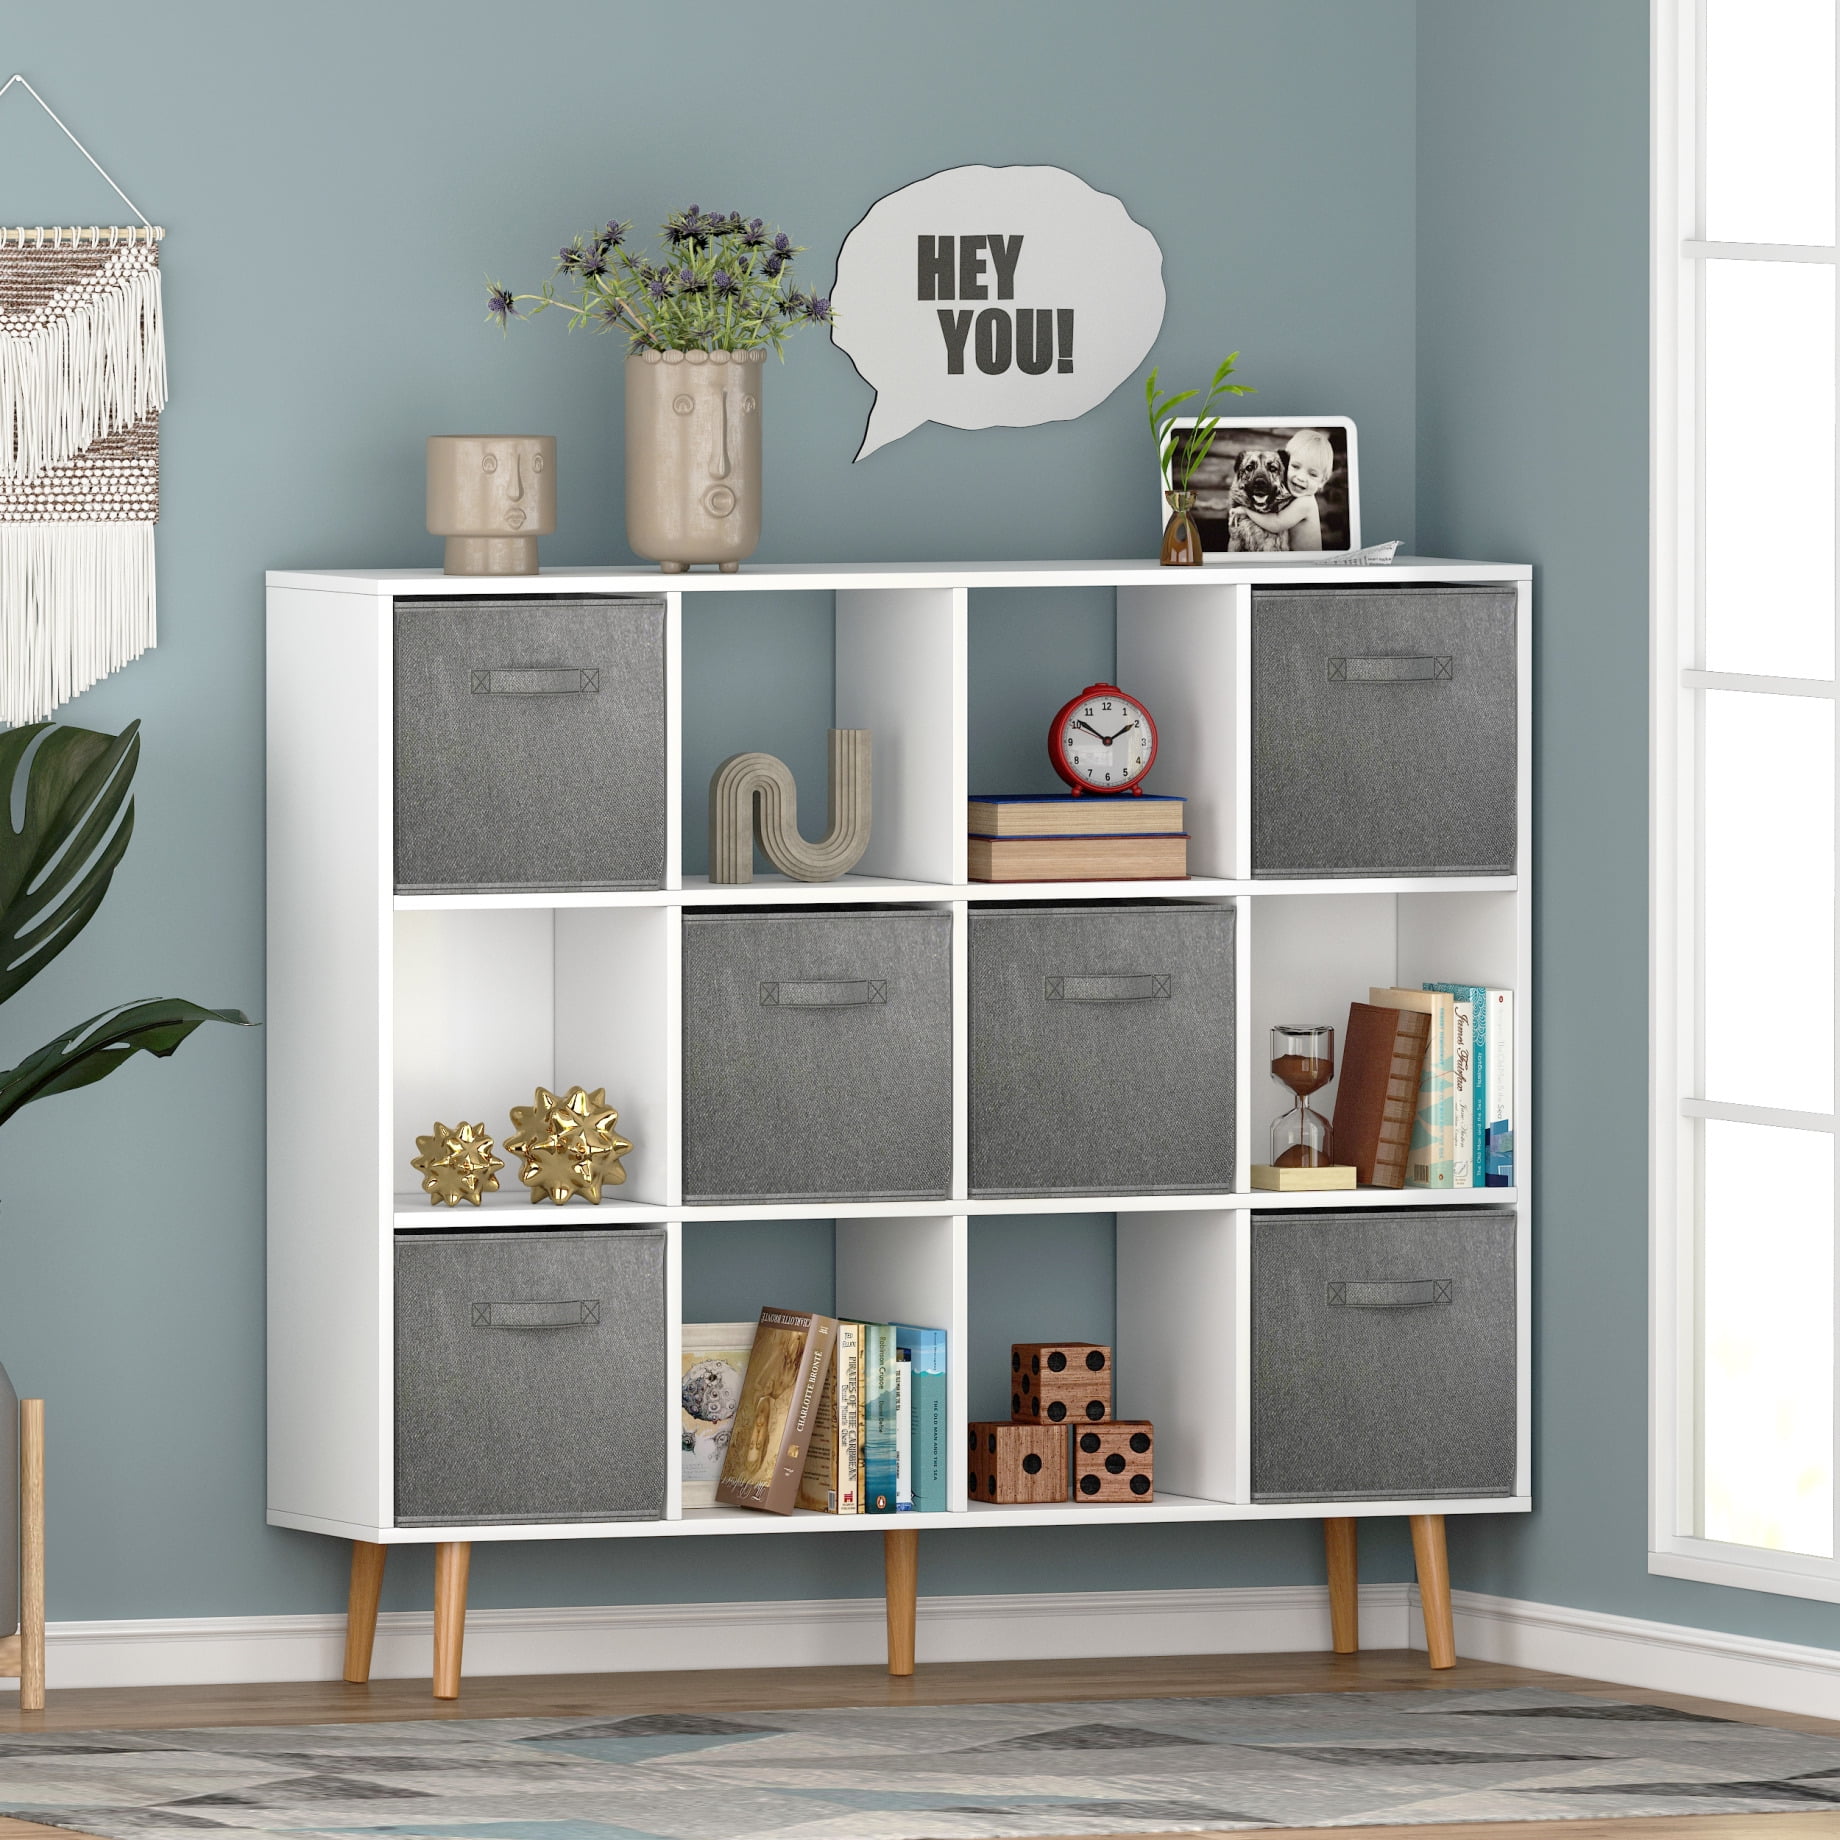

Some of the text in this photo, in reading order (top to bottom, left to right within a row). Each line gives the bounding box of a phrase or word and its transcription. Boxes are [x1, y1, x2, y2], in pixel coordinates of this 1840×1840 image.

[917, 234, 1024, 301] HEY
[937, 307, 1074, 375] YOU!
[1102, 702, 1112, 711] 12
[1085, 708, 1094, 716] 11
[1122, 707, 1128, 716] 1
[1134, 720, 1140, 728] 2
[1067, 738, 1073, 746] 9
[1141, 738, 1147, 746] 3
[1074, 756, 1079, 764] 8
[1135, 756, 1141, 764] 4
[1087, 769, 1093, 777] 7
[1122, 768, 1128, 776] 5
[1105, 773, 1110, 781] 6
[1454, 1006, 1469, 1092] James Fairfax
[1497, 1104, 1505, 1120] Sea
[846, 1356, 856, 1393] PIRATES
[878, 1367, 886, 1390] Crusoe
[847, 1394, 856, 1409] OF
[797, 1382, 814, 1432] CHARLOTTE
[848, 1411, 856, 1428] THE
[846, 1430, 856, 1481] CARIBBEAN
